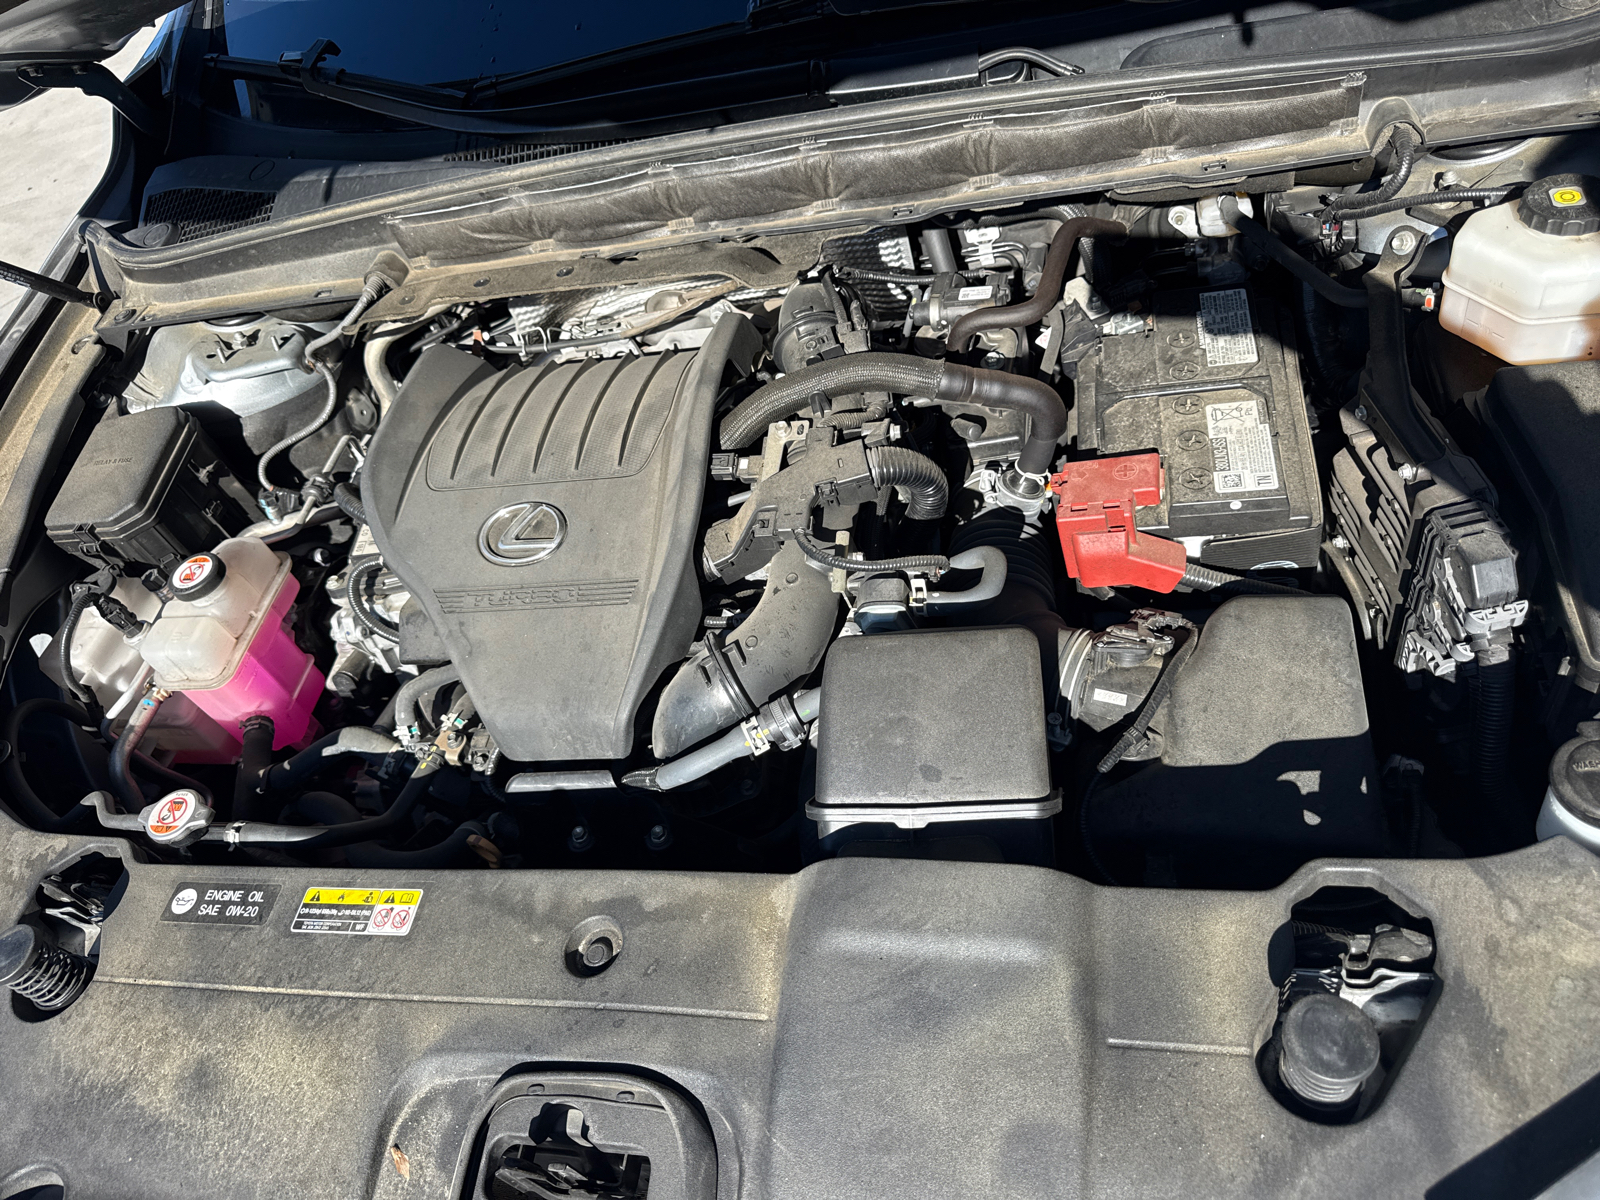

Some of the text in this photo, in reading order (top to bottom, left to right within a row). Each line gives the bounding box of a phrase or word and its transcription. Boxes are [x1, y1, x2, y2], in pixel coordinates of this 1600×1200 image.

[1256, 475, 1272, 486] TN
[467, 588, 575, 607] TURBO
[204, 889, 265, 902] ENGINE OIL
[198, 904, 260, 918] SAE 0W-20
